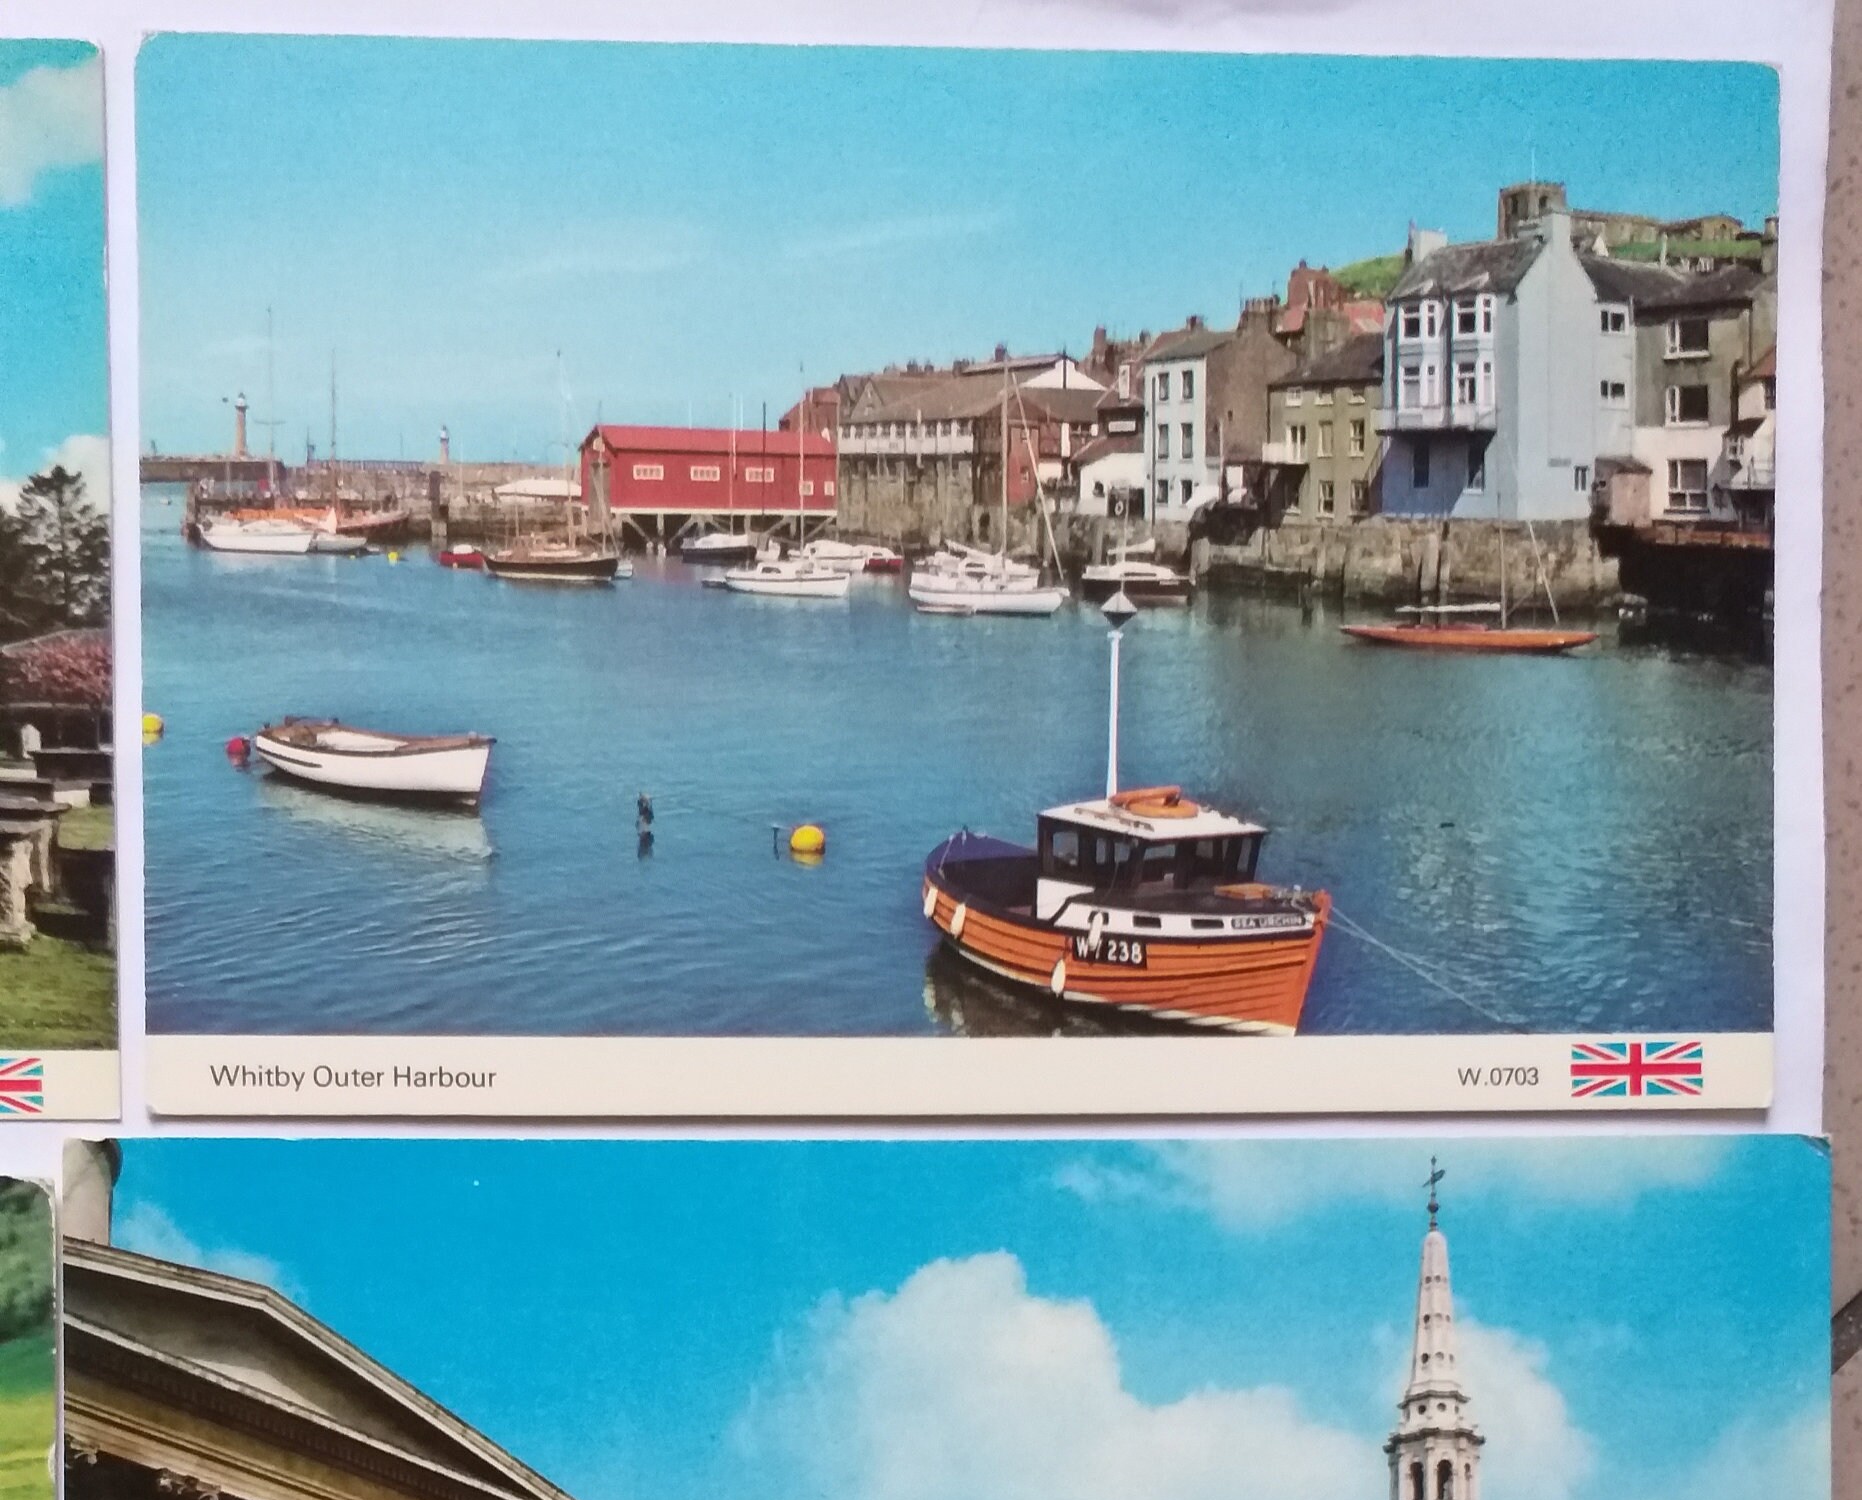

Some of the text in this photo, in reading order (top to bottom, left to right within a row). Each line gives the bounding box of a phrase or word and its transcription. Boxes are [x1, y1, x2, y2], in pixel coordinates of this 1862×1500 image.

[1108, 939, 1143, 965] 238
[210, 1064, 497, 1092] Whitby Outer Harbour
[1458, 1066, 1540, 1086] W.0703
